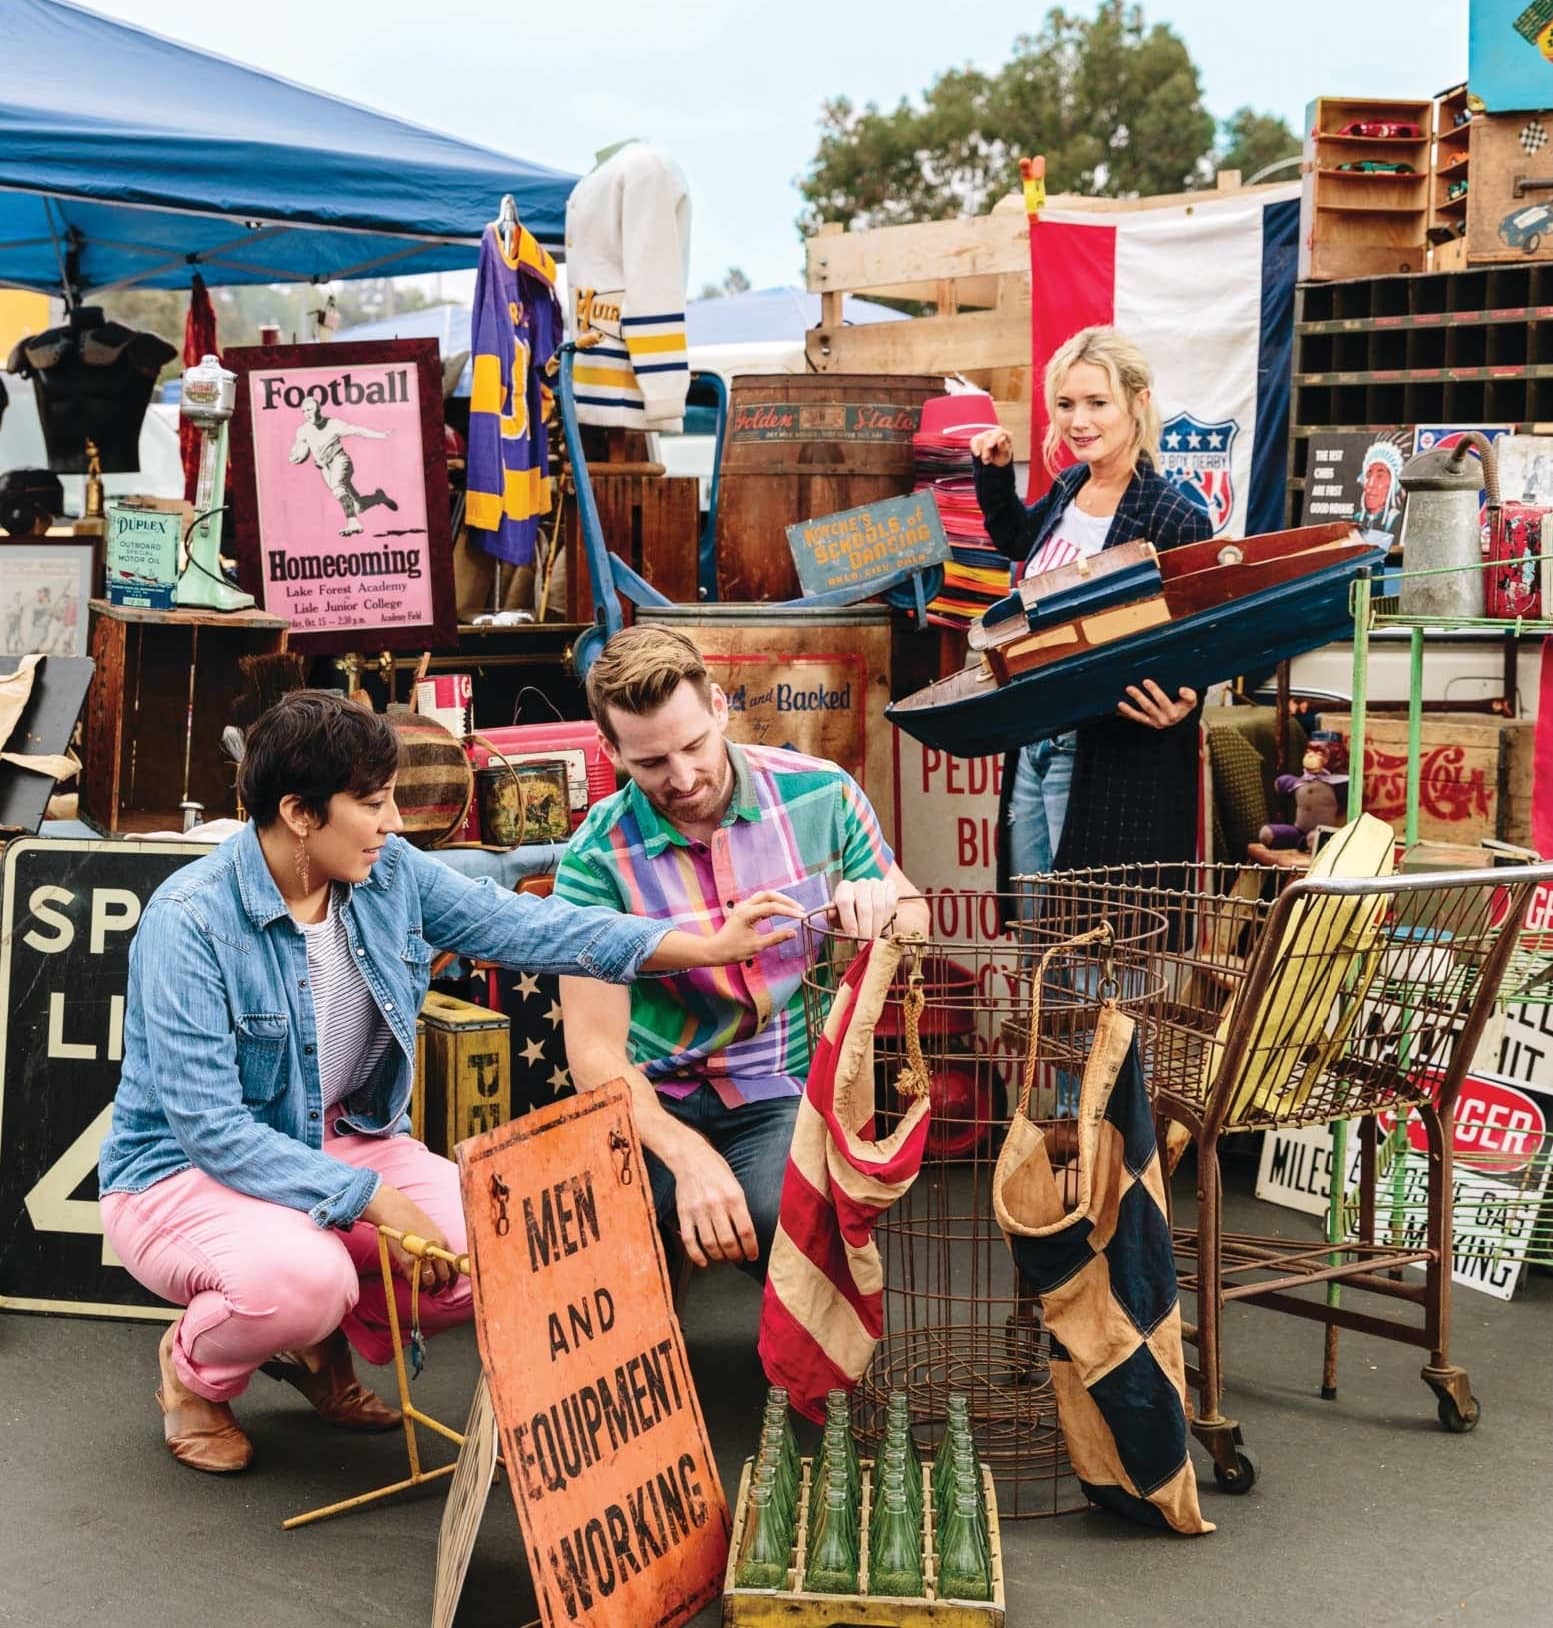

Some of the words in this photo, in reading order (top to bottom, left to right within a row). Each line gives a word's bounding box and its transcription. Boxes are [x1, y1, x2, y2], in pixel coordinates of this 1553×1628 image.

[260, 370, 409, 410] Football
[735, 406, 793, 432] Golden
[854, 407, 912, 430] State
[117, 517, 168, 534] DUPLEX
[118, 555, 145, 563] MOTOR
[119, 541, 161, 550] OUTBOARD
[268, 544, 422, 582] Homecoming
[286, 586, 313, 598] Lake
[319, 584, 352, 595] Forest
[358, 580, 407, 593] Academy
[294, 603, 319, 614] Lisle
[324, 601, 358, 612] Junior
[363, 598, 402, 610] College
[750, 688, 773, 708] and
[777, 683, 851, 712] Backed
[523, 1171, 601, 1273] MEN
[548, 1287, 615, 1362] AND
[513, 1339, 683, 1501] EQUIPMENT
[549, 1453, 708, 1620] WORKING
